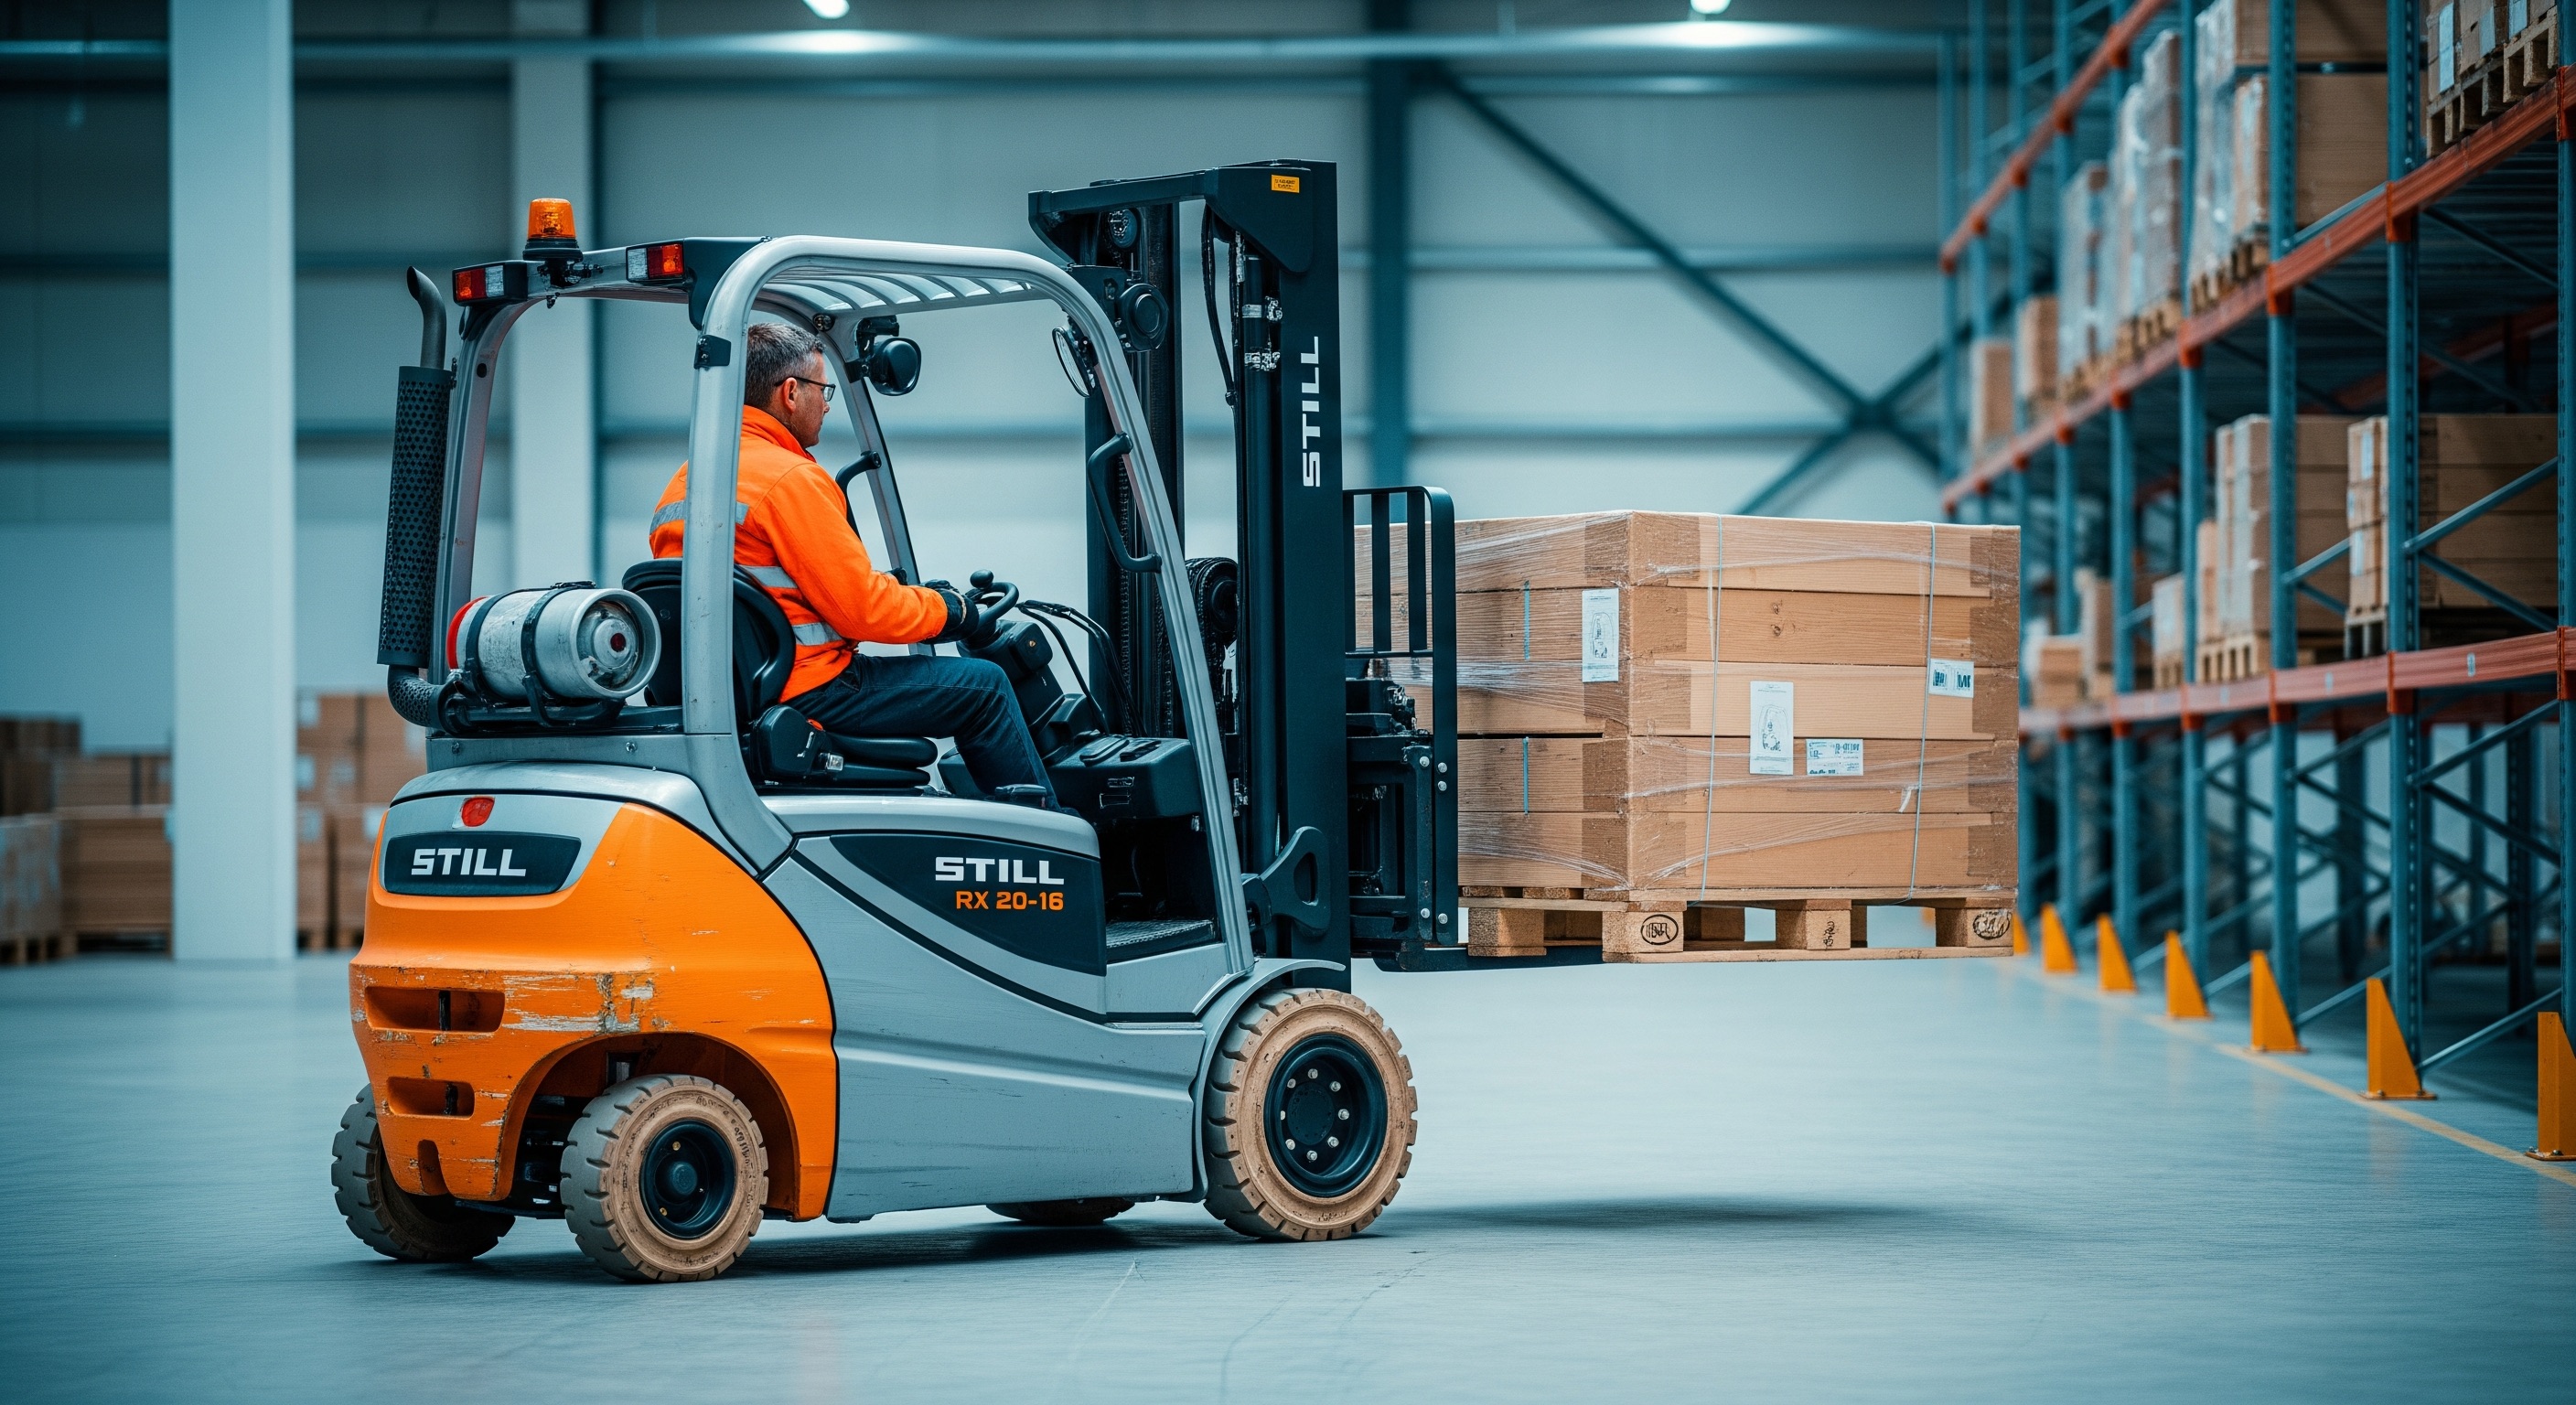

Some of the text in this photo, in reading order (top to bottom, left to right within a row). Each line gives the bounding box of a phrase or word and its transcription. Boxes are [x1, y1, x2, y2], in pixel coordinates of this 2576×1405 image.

[1300, 336, 1321, 488] STILL
[411, 848, 527, 876] STILL
[935, 856, 1065, 885] STILL
[956, 890, 1064, 911] RX 20-16
